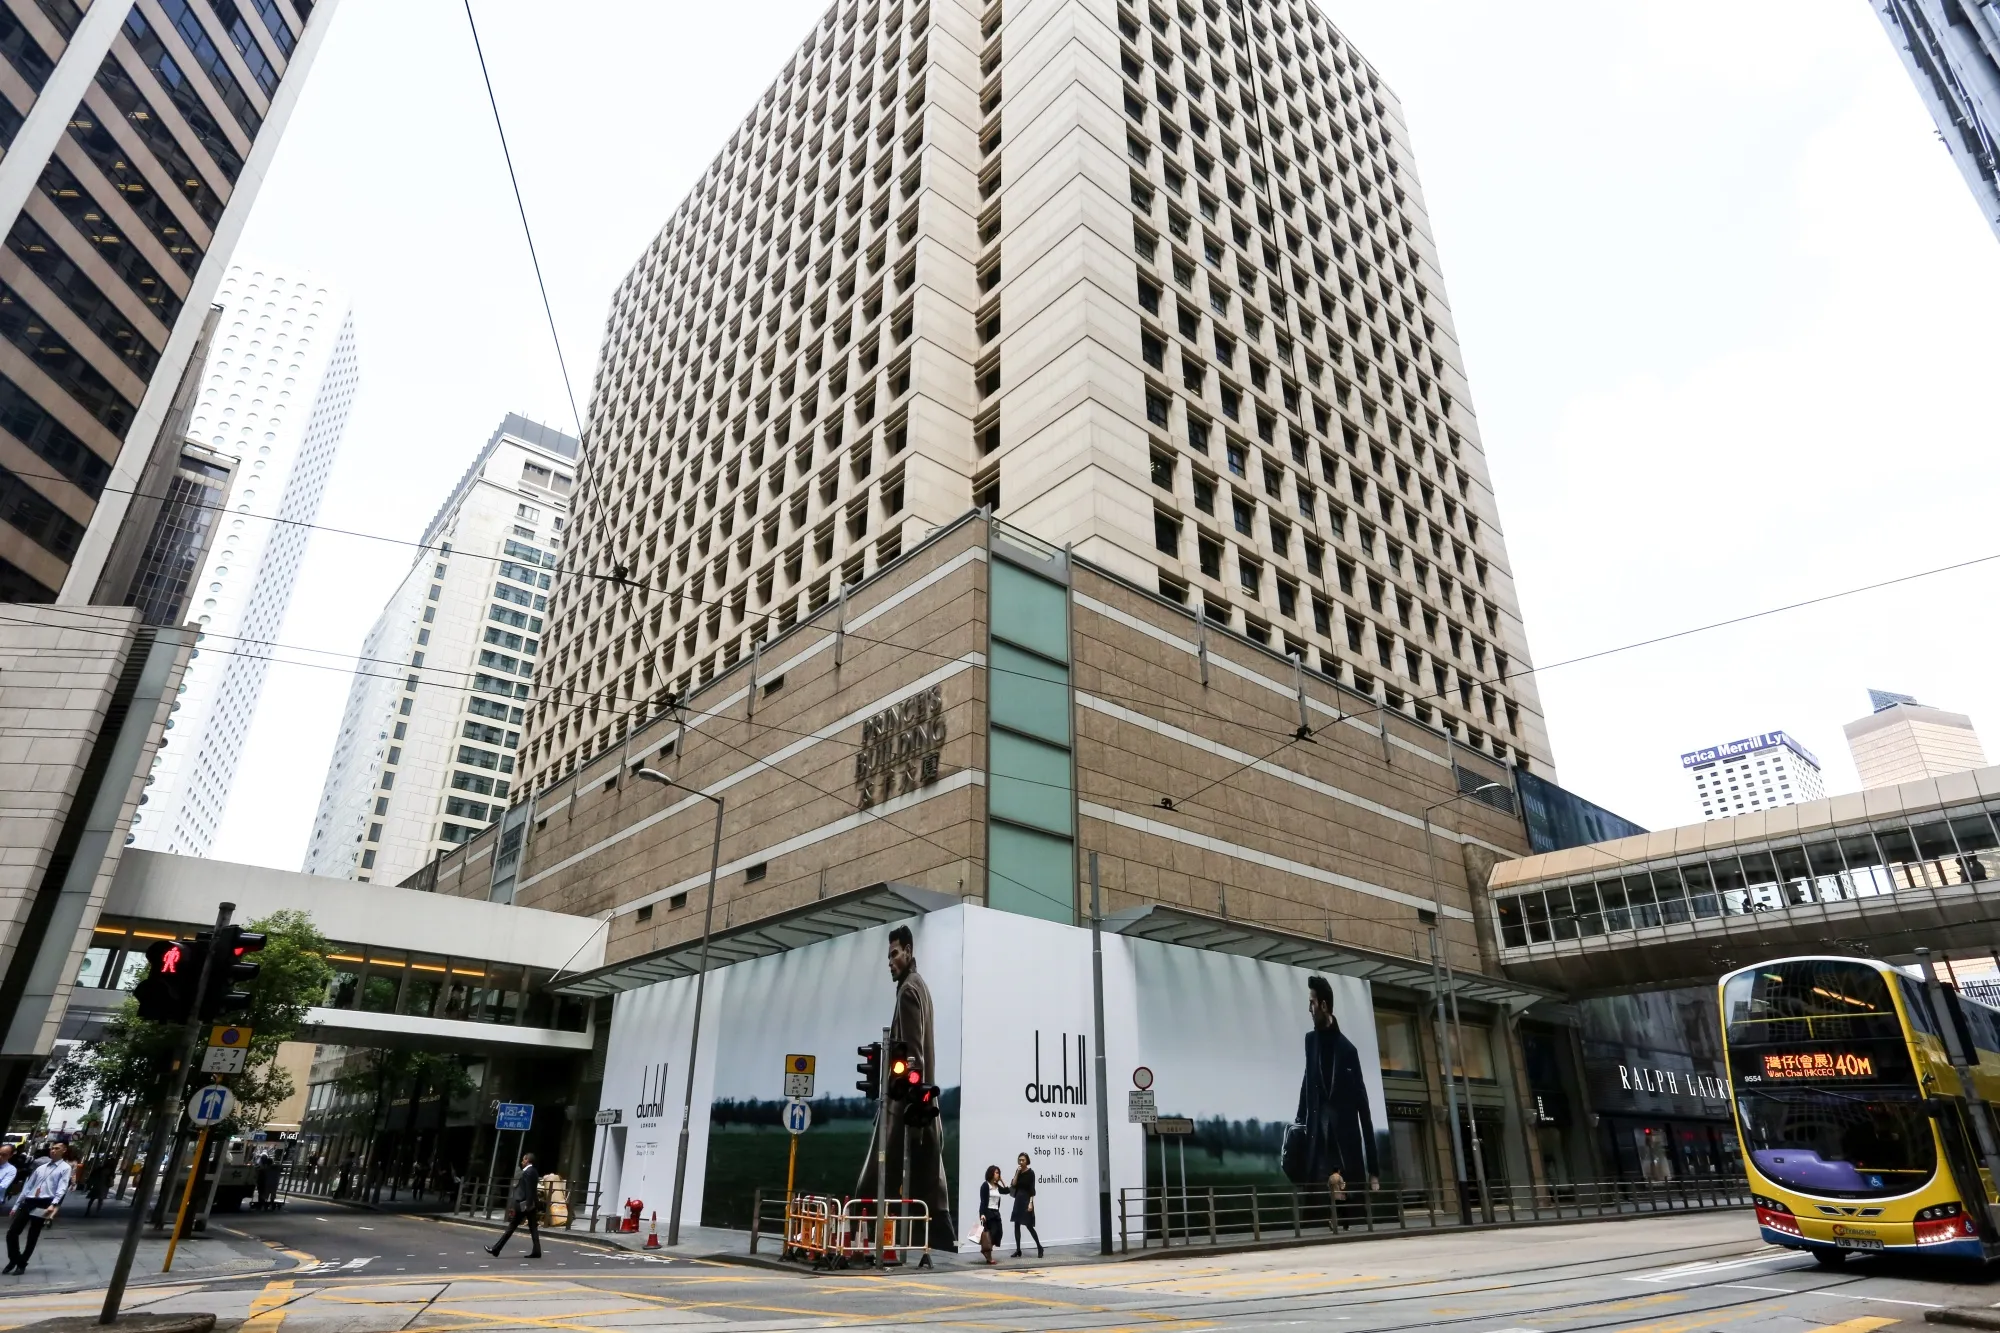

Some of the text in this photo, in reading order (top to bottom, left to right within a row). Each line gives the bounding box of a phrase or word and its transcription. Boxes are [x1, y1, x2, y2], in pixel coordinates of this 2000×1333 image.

[855, 718, 946, 778] BUILDING
[1683, 750, 1716, 765] erica
[1717, 735, 1763, 757] Merrill
[233, 1050, 240, 1058] 7
[229, 1063, 236, 1072] 7
[1025, 1029, 1087, 1105] dunhill
[1764, 1053, 1872, 1076] 灣仔(會展) 40M
[1767, 1070, 1785, 1078] Wan
[1785, 1069, 1803, 1078] Chai
[1618, 1065, 1679, 1095] RALPH
[636, 1062, 668, 1119] dunhill
[1039, 1110, 1076, 1119] LONDON
[1027, 1132, 1045, 1140] Please
[1046, 1132, 1058, 1140] visit
[1034, 1146, 1051, 1157] Shop
[1054, 1147, 1065, 1156] 115
[1072, 1147, 1083, 1156] 116
[1037, 1174, 1079, 1184] dunhill.com
[1838, 1239, 1880, 1249] UB 7573
